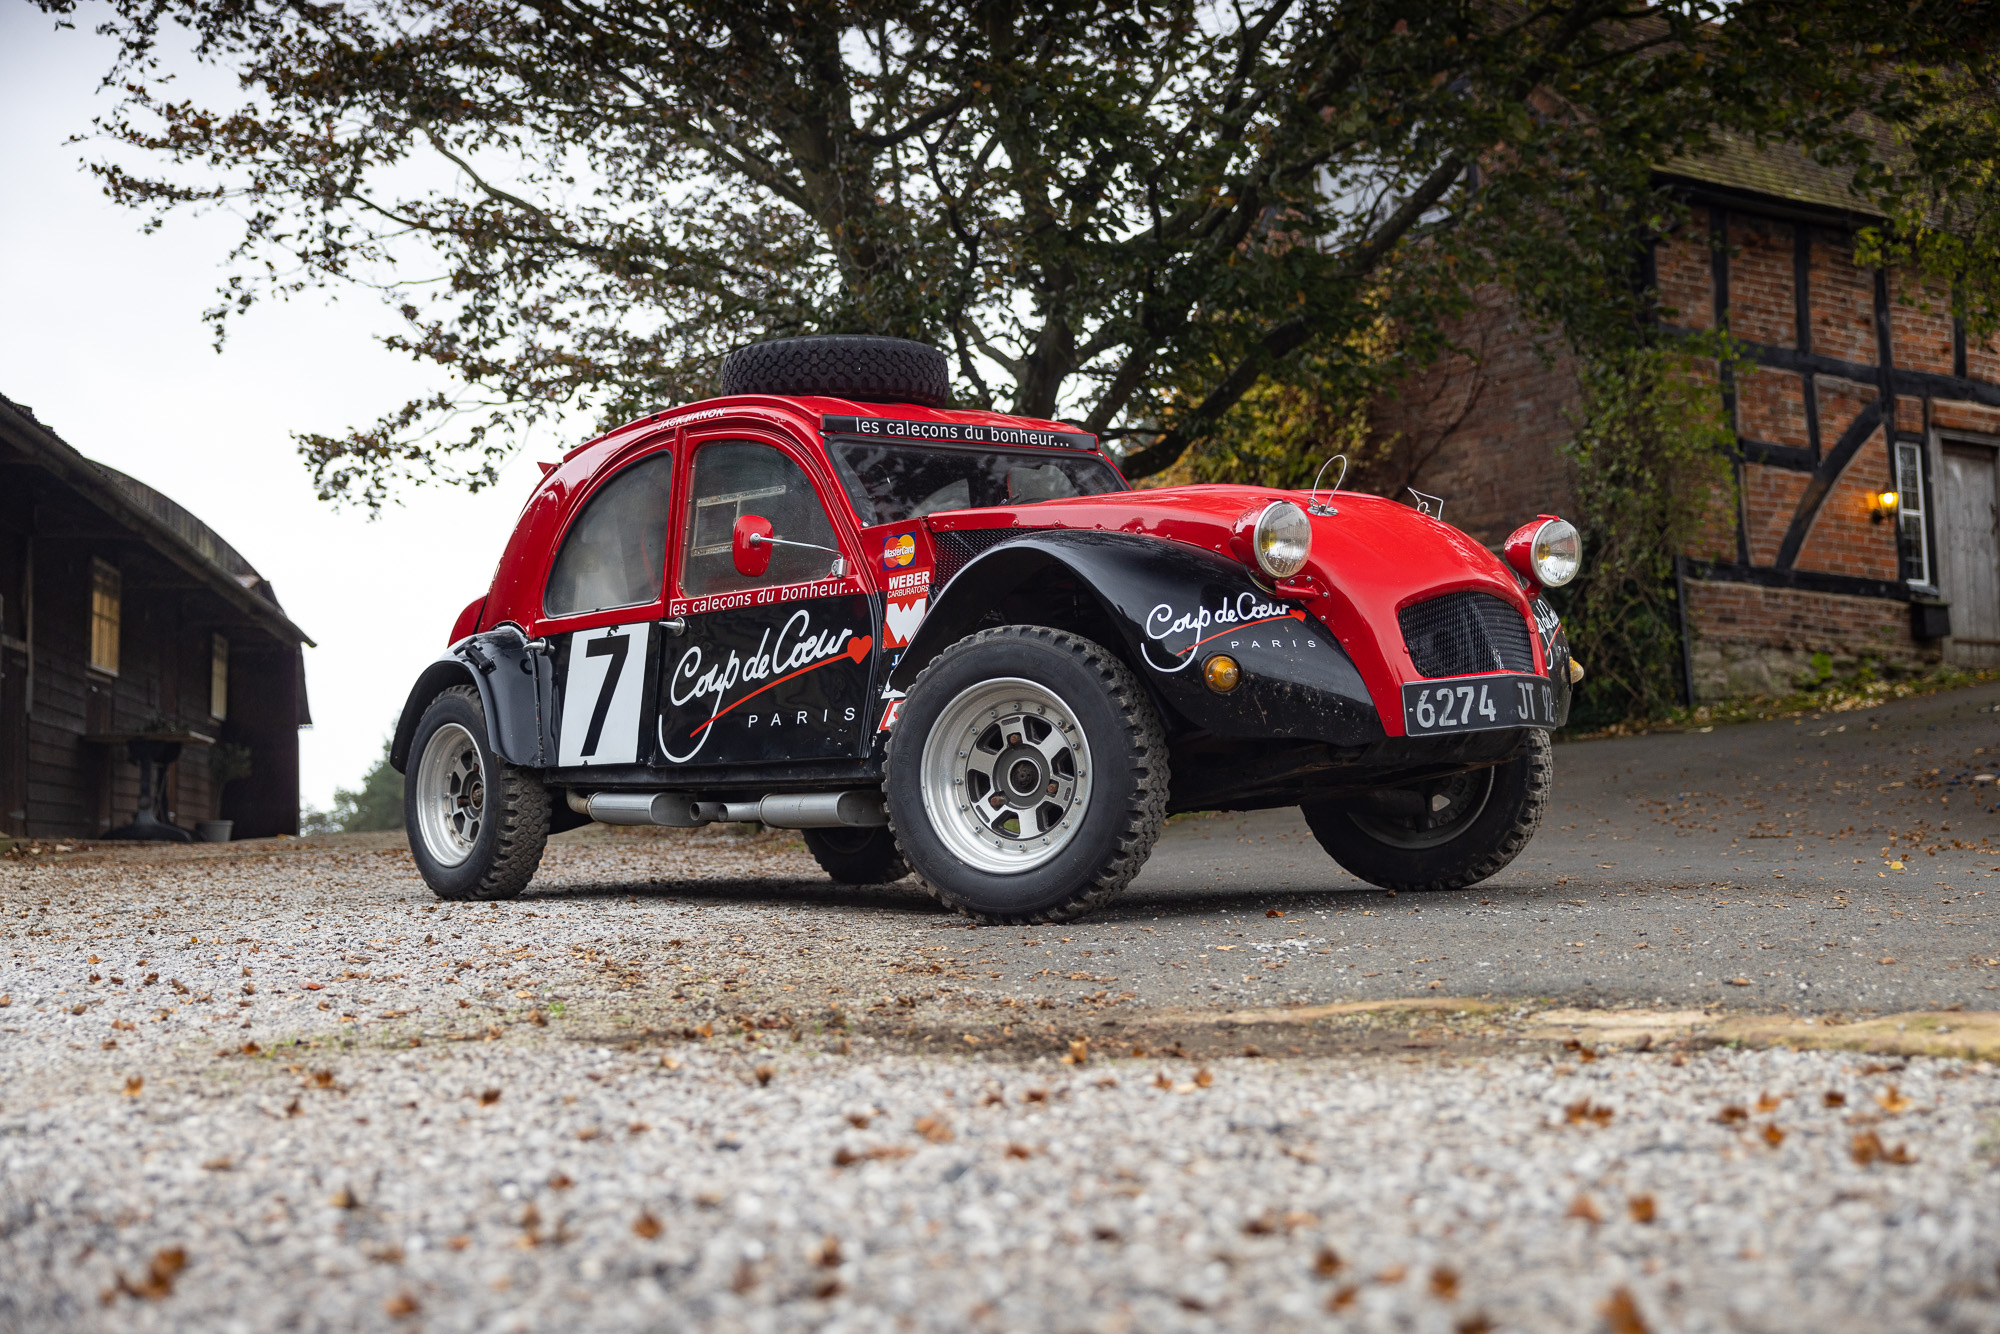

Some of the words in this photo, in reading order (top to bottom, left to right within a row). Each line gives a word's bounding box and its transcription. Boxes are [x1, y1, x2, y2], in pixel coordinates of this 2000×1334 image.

[684, 408, 726, 423] HANON
[855, 417, 880, 433] les
[886, 420, 958, 439] caleçons
[965, 425, 984, 441] du
[991, 427, 1070, 447] bonheur...
[884, 544, 915, 559] MasterCard
[887, 585, 930, 599] CARBURATORS
[888, 570, 930, 590] WEBER
[669, 602, 687, 617] les
[692, 592, 752, 613] caleçons
[757, 588, 775, 604] du
[781, 580, 860, 600] bonheur...
[1140, 603, 1211, 673] Coup
[1214, 596, 1238, 623] de
[1230, 639, 1316, 649] PARIS
[580, 633, 631, 757] 7
[658, 646, 740, 764] Coup
[742, 627, 770, 682] de
[1416, 684, 1497, 729] 6274
[1517, 682, 1536, 720] JT
[748, 707, 856, 728] PARIS
